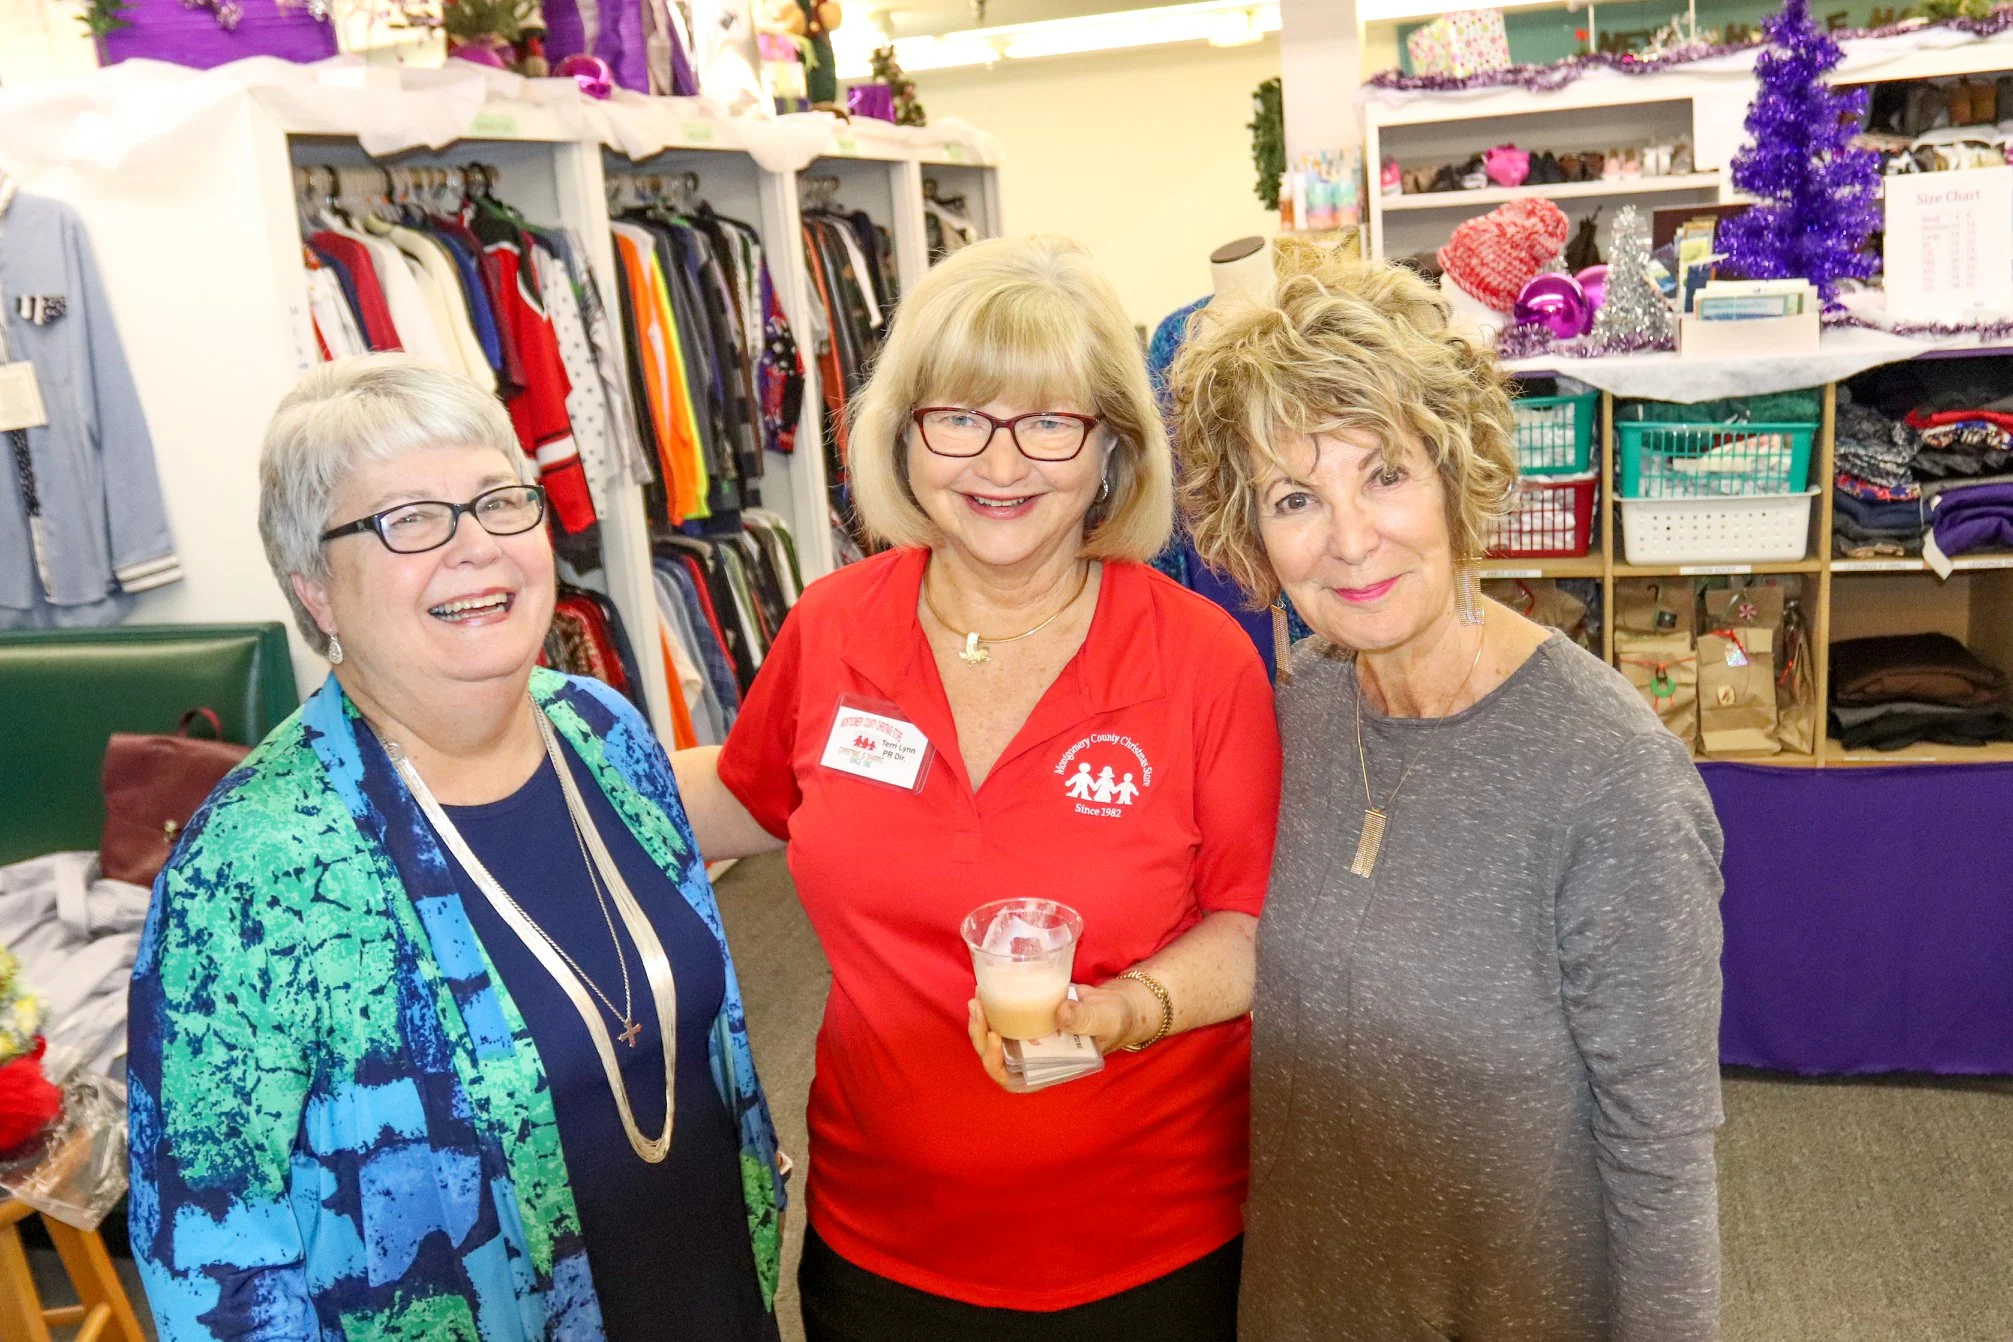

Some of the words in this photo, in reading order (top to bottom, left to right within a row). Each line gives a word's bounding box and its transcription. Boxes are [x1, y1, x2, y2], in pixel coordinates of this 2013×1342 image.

[1916, 192, 1943, 206] Size
[1945, 189, 1981, 203] Chart
[882, 739, 898, 750] Terri
[899, 744, 917, 755] Lynn
[882, 749, 893, 759] PR
[1054, 738, 1090, 776] Montgomery
[1090, 733, 1121, 746] County
[1120, 736, 1149, 768] Christmas
[1142, 766, 1153, 787] Store
[1075, 803, 1100, 816] Since
[1101, 807, 1122, 818] 1982
